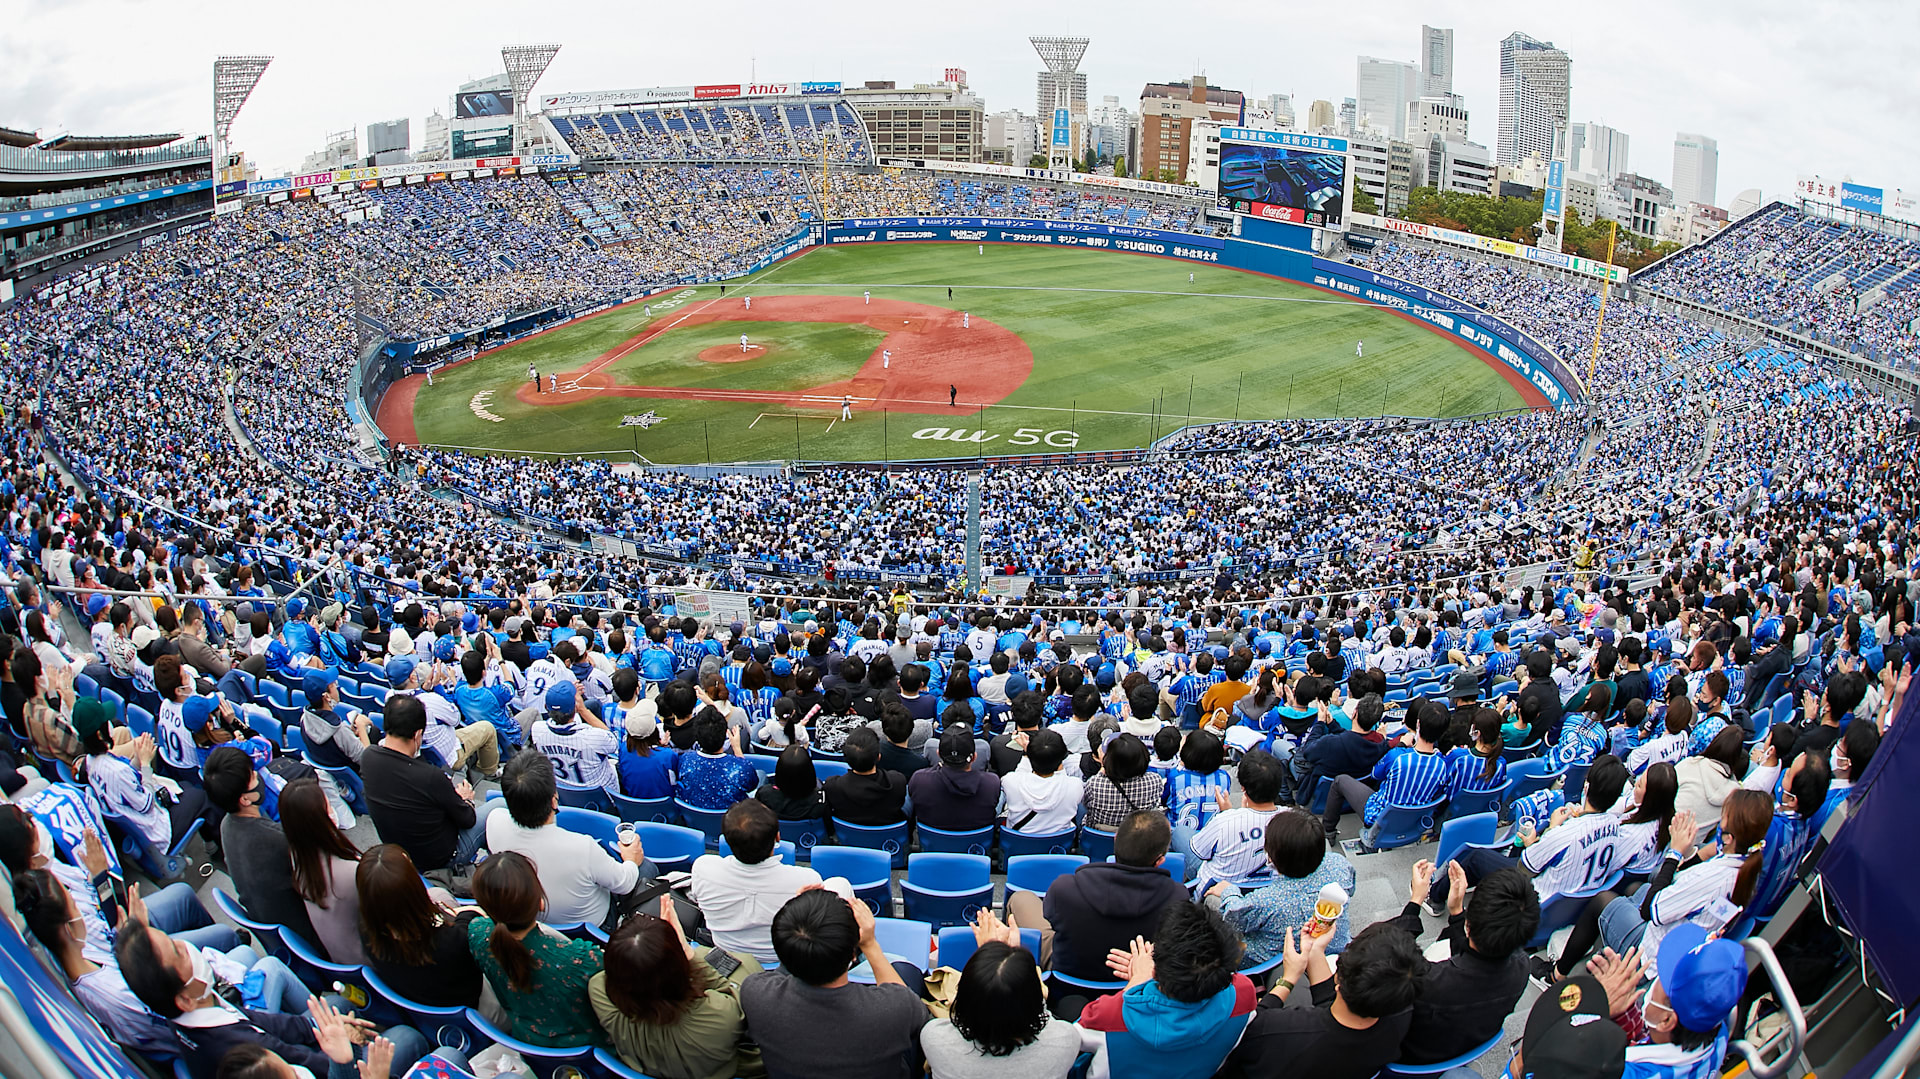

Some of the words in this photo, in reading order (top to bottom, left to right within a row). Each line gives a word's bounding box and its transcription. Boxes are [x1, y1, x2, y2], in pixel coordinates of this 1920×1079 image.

[748, 84, 788, 95] オカムラ
[1248, 112, 1265, 120] YMCA
[533, 155, 569, 164] ウスイホーム
[1122, 240, 1165, 254] SUGIKO
[414, 338, 436, 355] ノジマ
[912, 427, 1000, 442] au
[1008, 428, 1080, 448] 5G
[975, 636, 983, 650] 5
[534, 677, 546, 696] 9
[743, 697, 769, 707] MORI
[1574, 724, 1599, 742] SEKINE
[541, 744, 584, 761] SHIBATA
[1560, 740, 1594, 765] 63
[551, 757, 586, 784] 31
[1179, 803, 1219, 830] 67
[1582, 842, 1614, 888] 19
